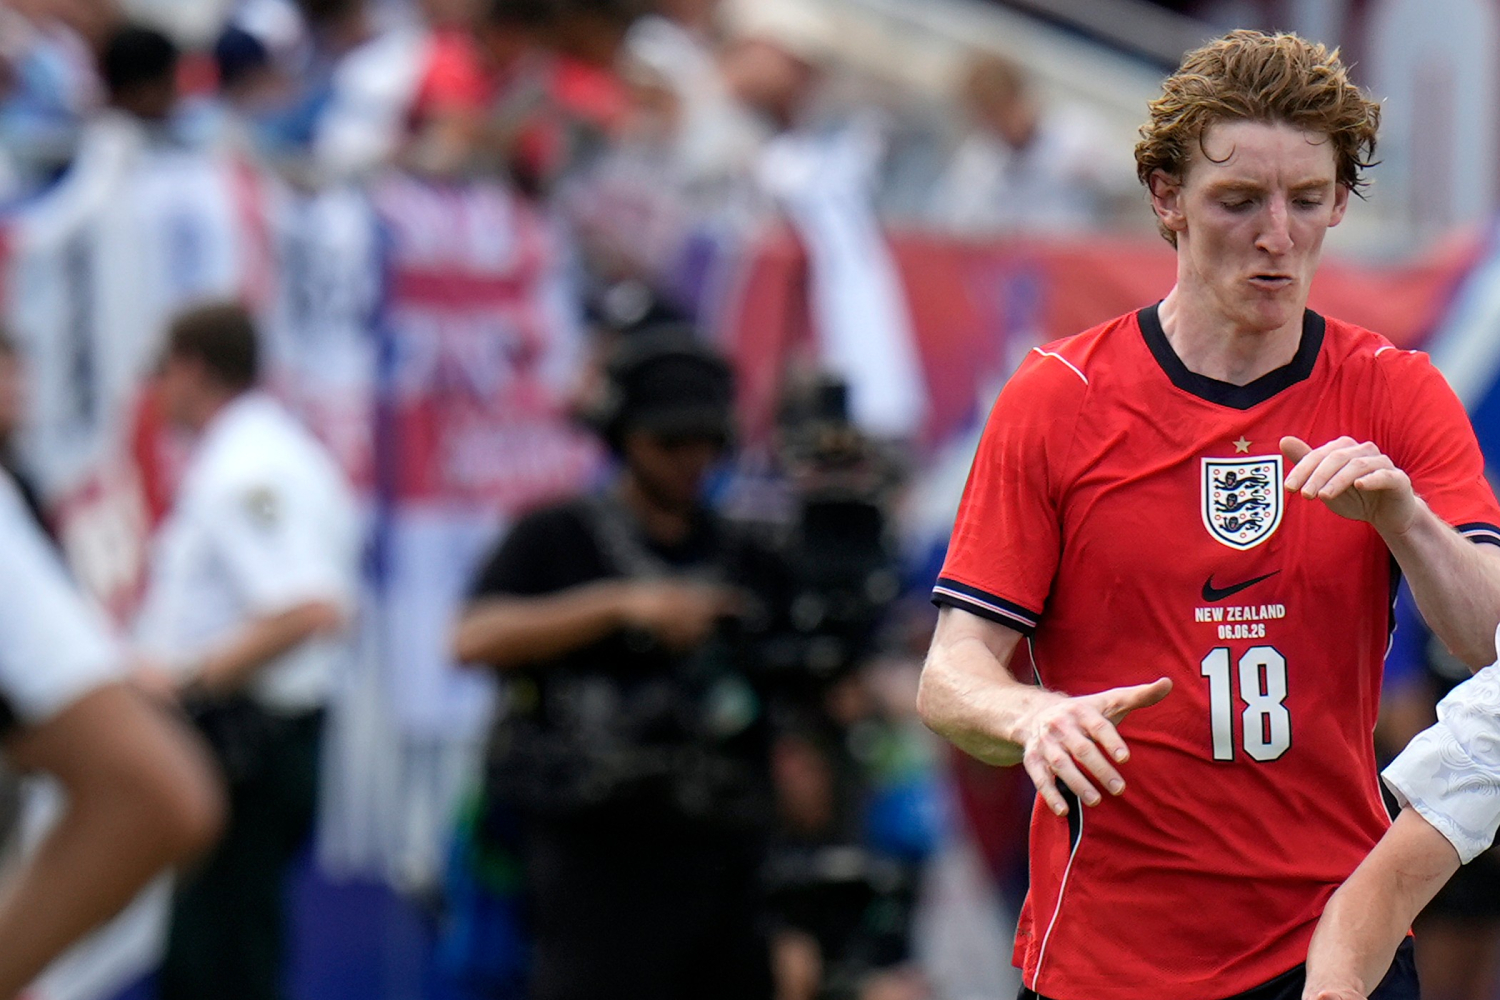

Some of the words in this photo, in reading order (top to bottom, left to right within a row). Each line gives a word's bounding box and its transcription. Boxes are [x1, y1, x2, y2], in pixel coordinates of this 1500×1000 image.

[1195, 607, 1224, 622] NEW
[1227, 604, 1286, 621] ZEALAND
[1218, 624, 1266, 639] 06.06.26
[1201, 645, 1292, 763] 18
